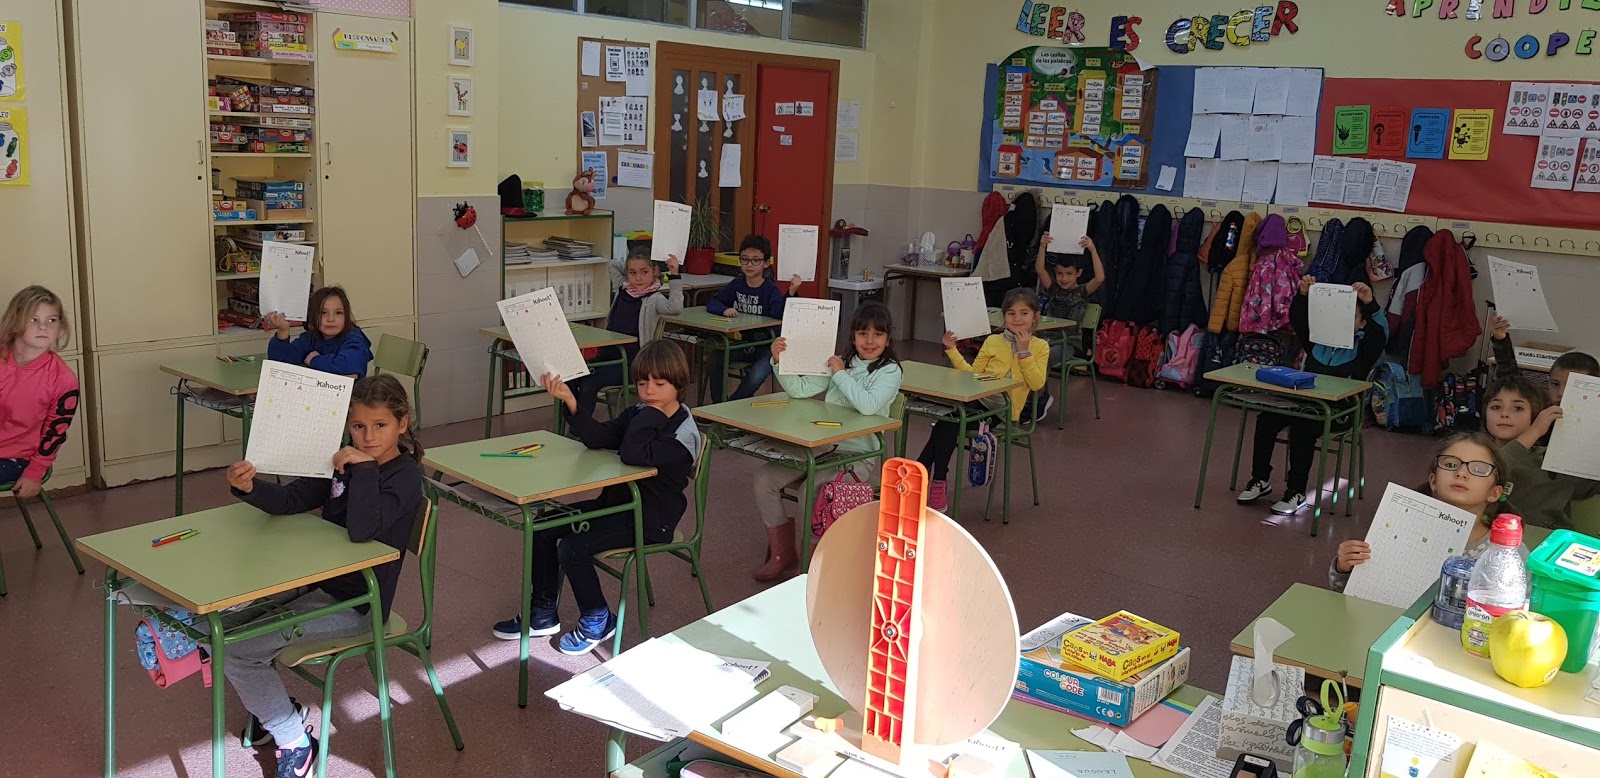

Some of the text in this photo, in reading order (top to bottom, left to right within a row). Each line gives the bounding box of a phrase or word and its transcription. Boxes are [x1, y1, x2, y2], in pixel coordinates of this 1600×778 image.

[1016, 0, 1299, 54] LEER ES CRECER
[1465, 29, 1597, 61] COOPE
[317, 380, 346, 392] Kahoot!
[1438, 512, 1468, 528] Kahoot!
[1099, 654, 1116, 667] HABA
[1044, 669, 1080, 686] COLOUR
[1060, 683, 1084, 696] CODE
